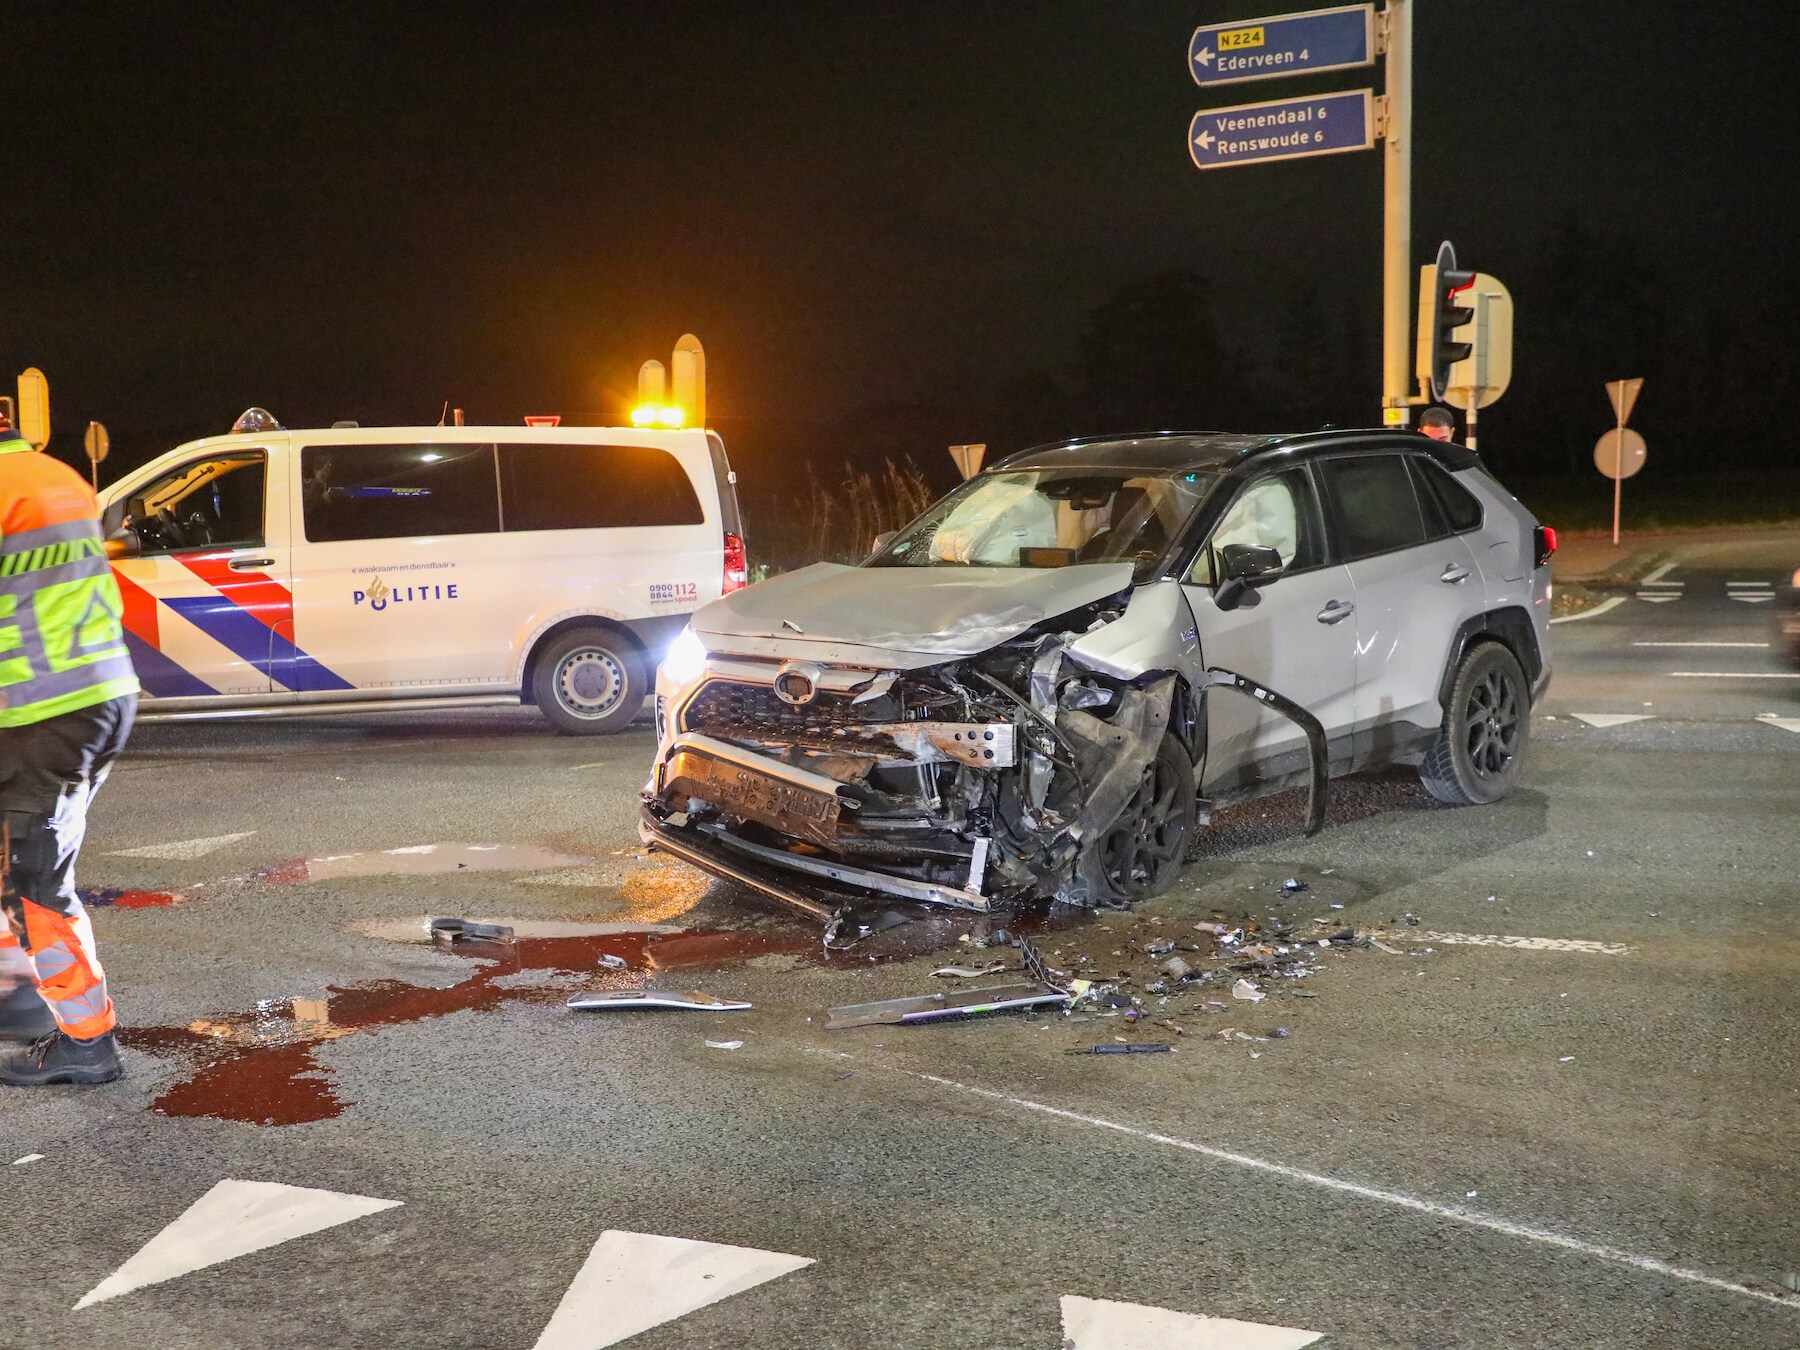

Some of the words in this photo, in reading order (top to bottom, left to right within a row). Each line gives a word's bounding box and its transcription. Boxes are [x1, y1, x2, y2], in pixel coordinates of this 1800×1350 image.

[1221, 36, 1230, 47] N
[1233, 31, 1261, 45] 224
[1217, 50, 1294, 72] Ederveen
[1299, 49, 1309, 61] 4
[1216, 106, 1313, 132] Veenendaal
[1317, 107, 1327, 120] 6
[1217, 131, 1309, 155] Renswoude
[1314, 130, 1324, 143] 6
[353, 584, 458, 611] POLITIE
[649, 584, 673, 592] 0900
[650, 592, 673, 600] 8844
[674, 582, 697, 595] 112
